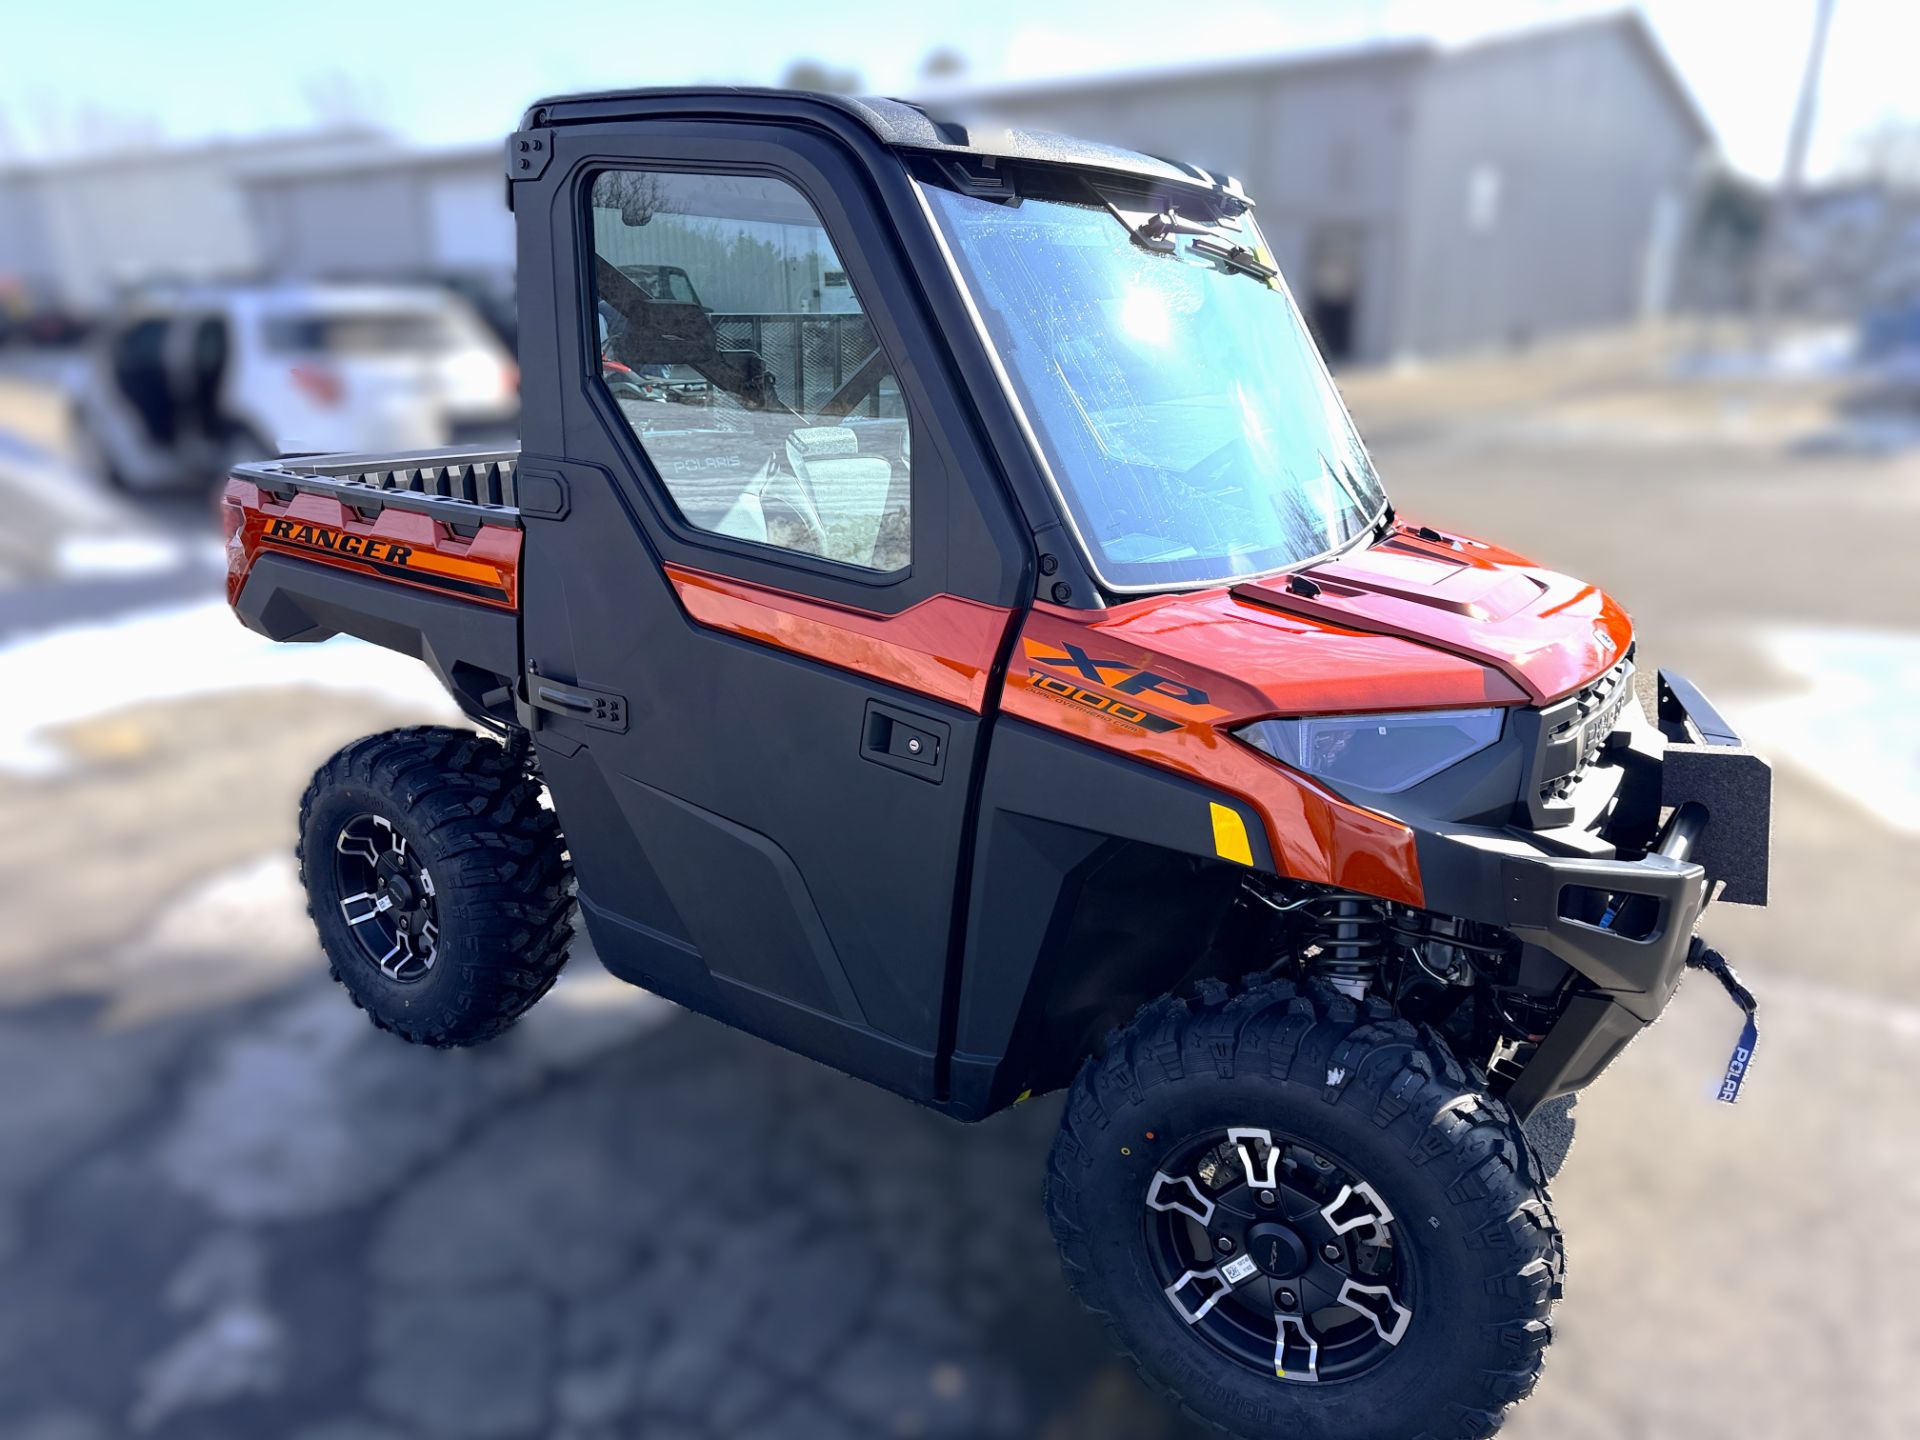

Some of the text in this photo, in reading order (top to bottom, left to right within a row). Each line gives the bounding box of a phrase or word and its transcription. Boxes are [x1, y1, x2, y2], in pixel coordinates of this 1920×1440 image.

[673, 454, 741, 474] POLARIS
[270, 518, 413, 566] RANGER
[1025, 671, 1147, 724] 1000
[1028, 639, 1212, 706] XP
